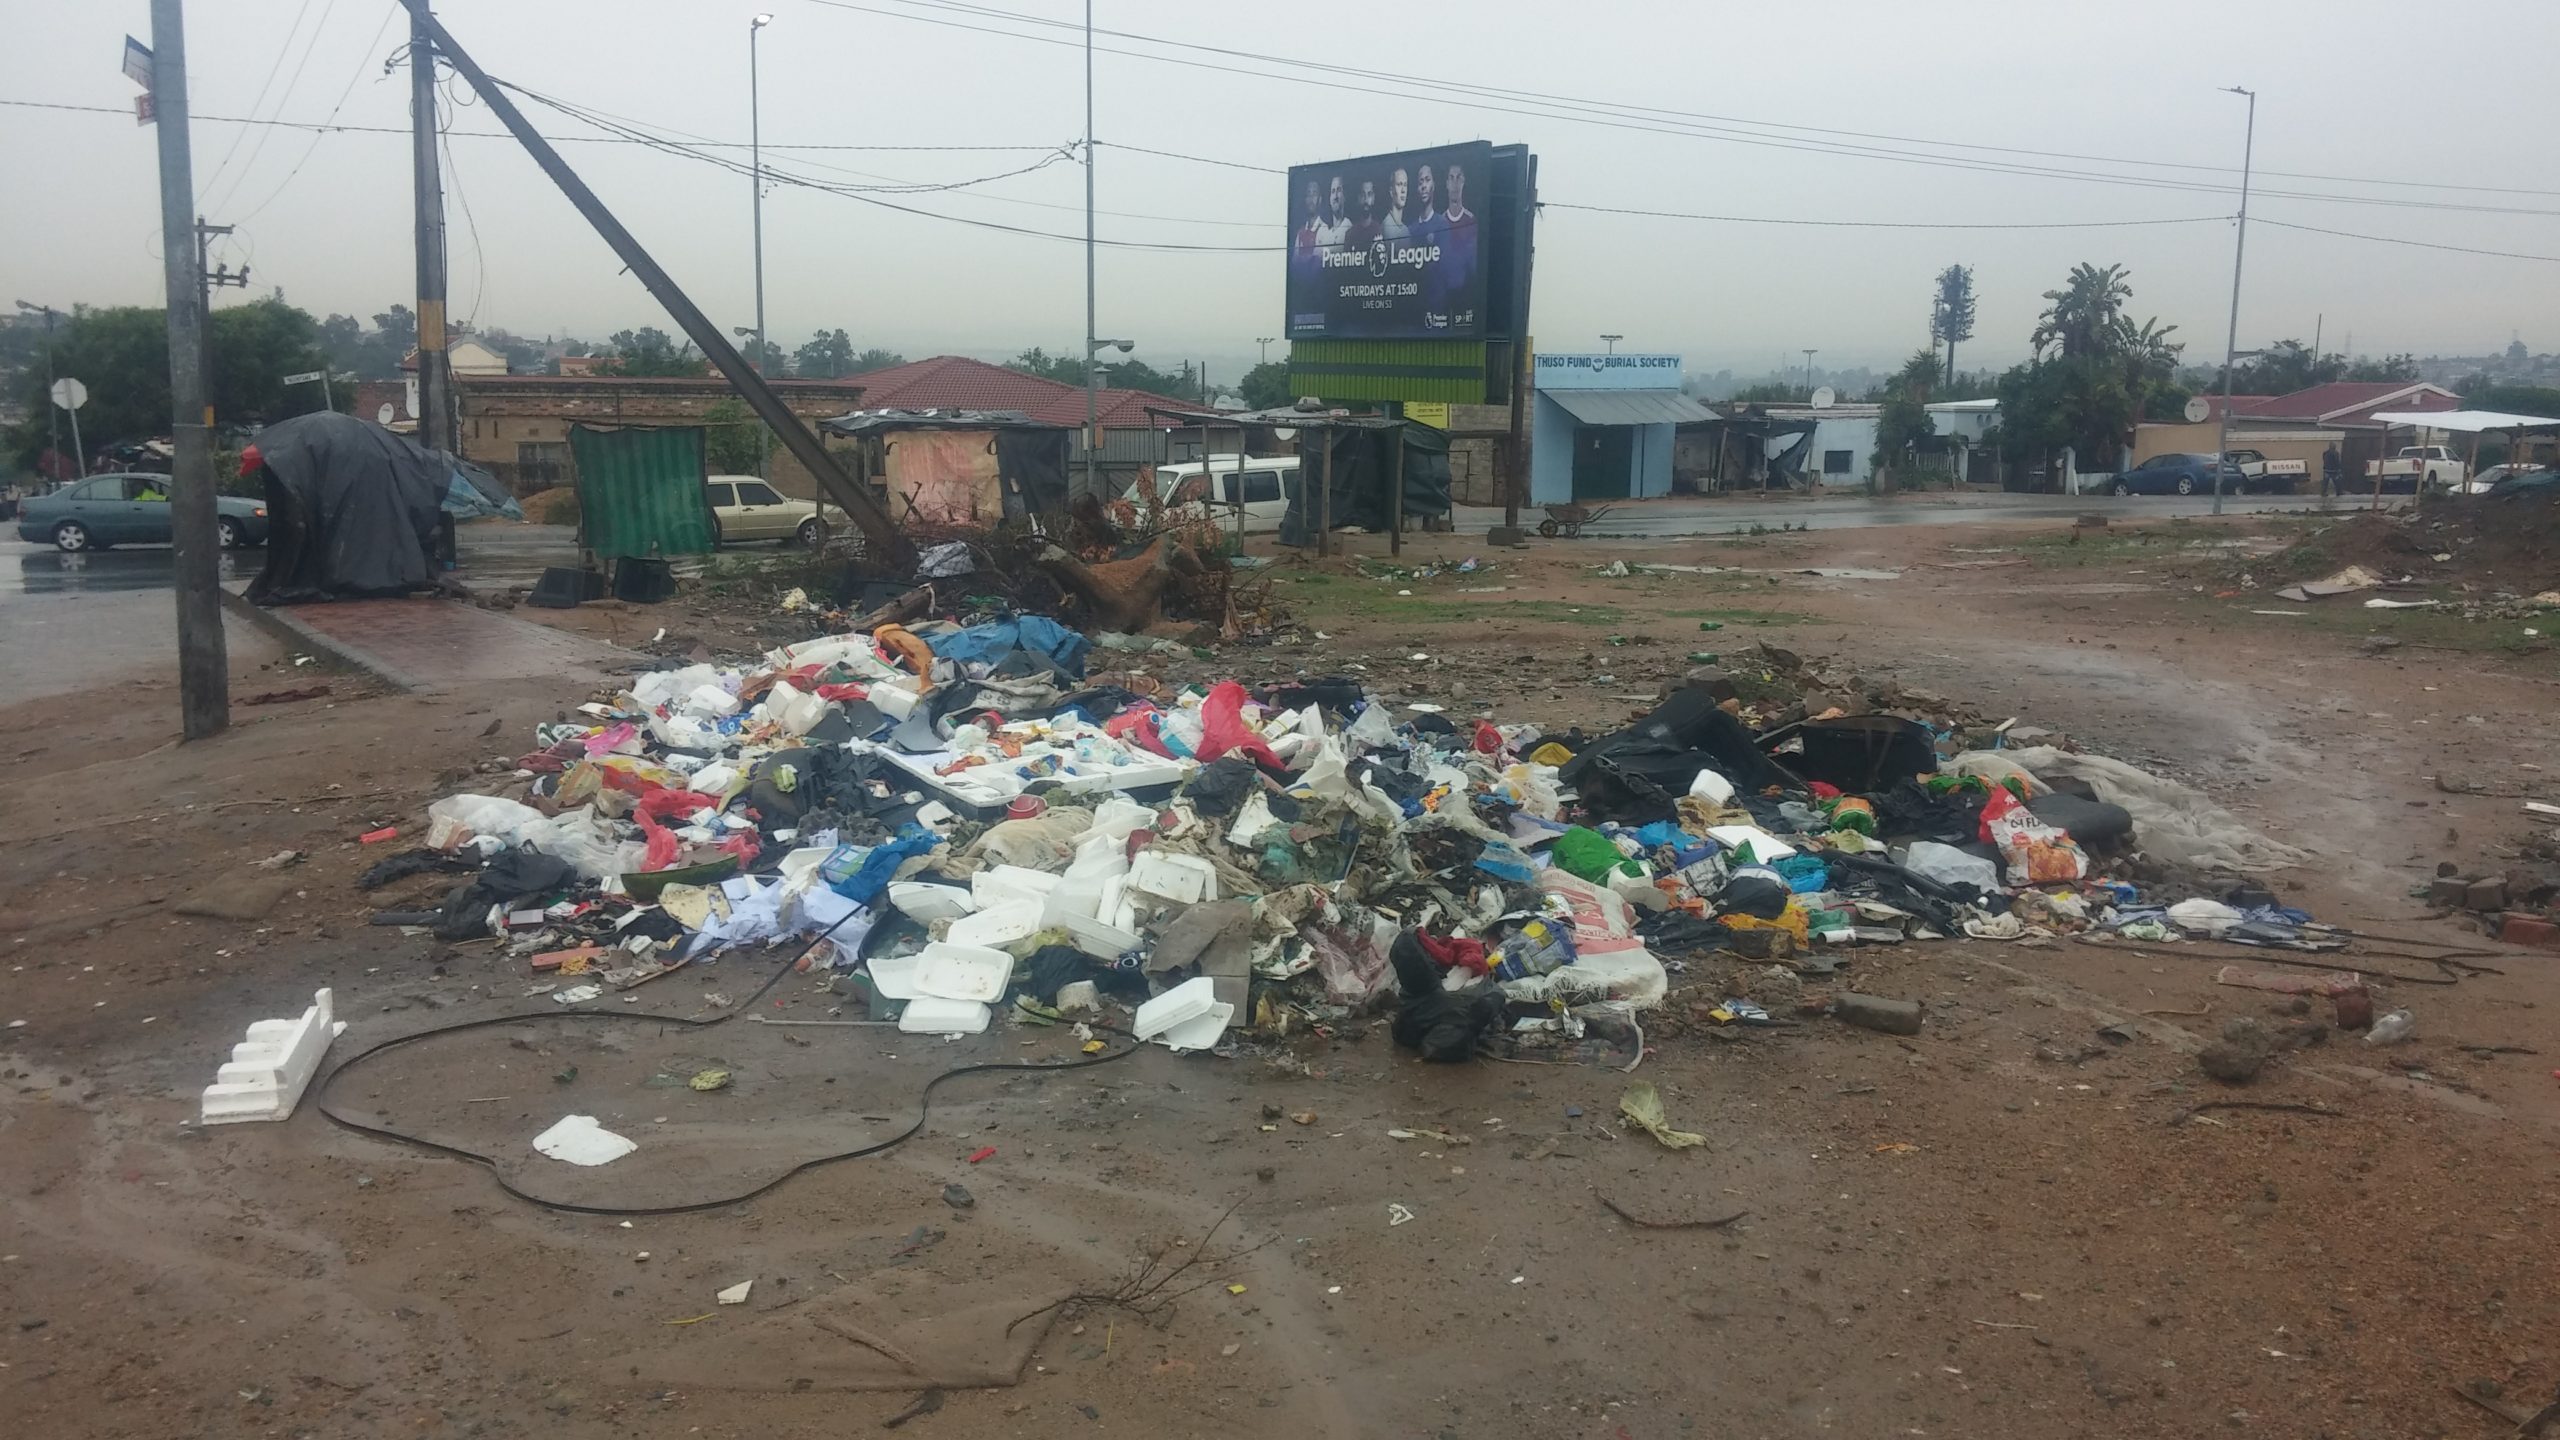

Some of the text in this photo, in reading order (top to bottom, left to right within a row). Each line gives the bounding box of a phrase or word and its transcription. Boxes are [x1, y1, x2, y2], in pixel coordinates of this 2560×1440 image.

[1322, 242, 1440, 269] Premier League
[1340, 283, 1418, 297] SATURDAYS AT 15:00
[1362, 300, 1375, 309] LIVE
[1375, 300, 1385, 309] ON
[1537, 356, 1680, 368] THUSO FUND BURIAL SOCIETY
